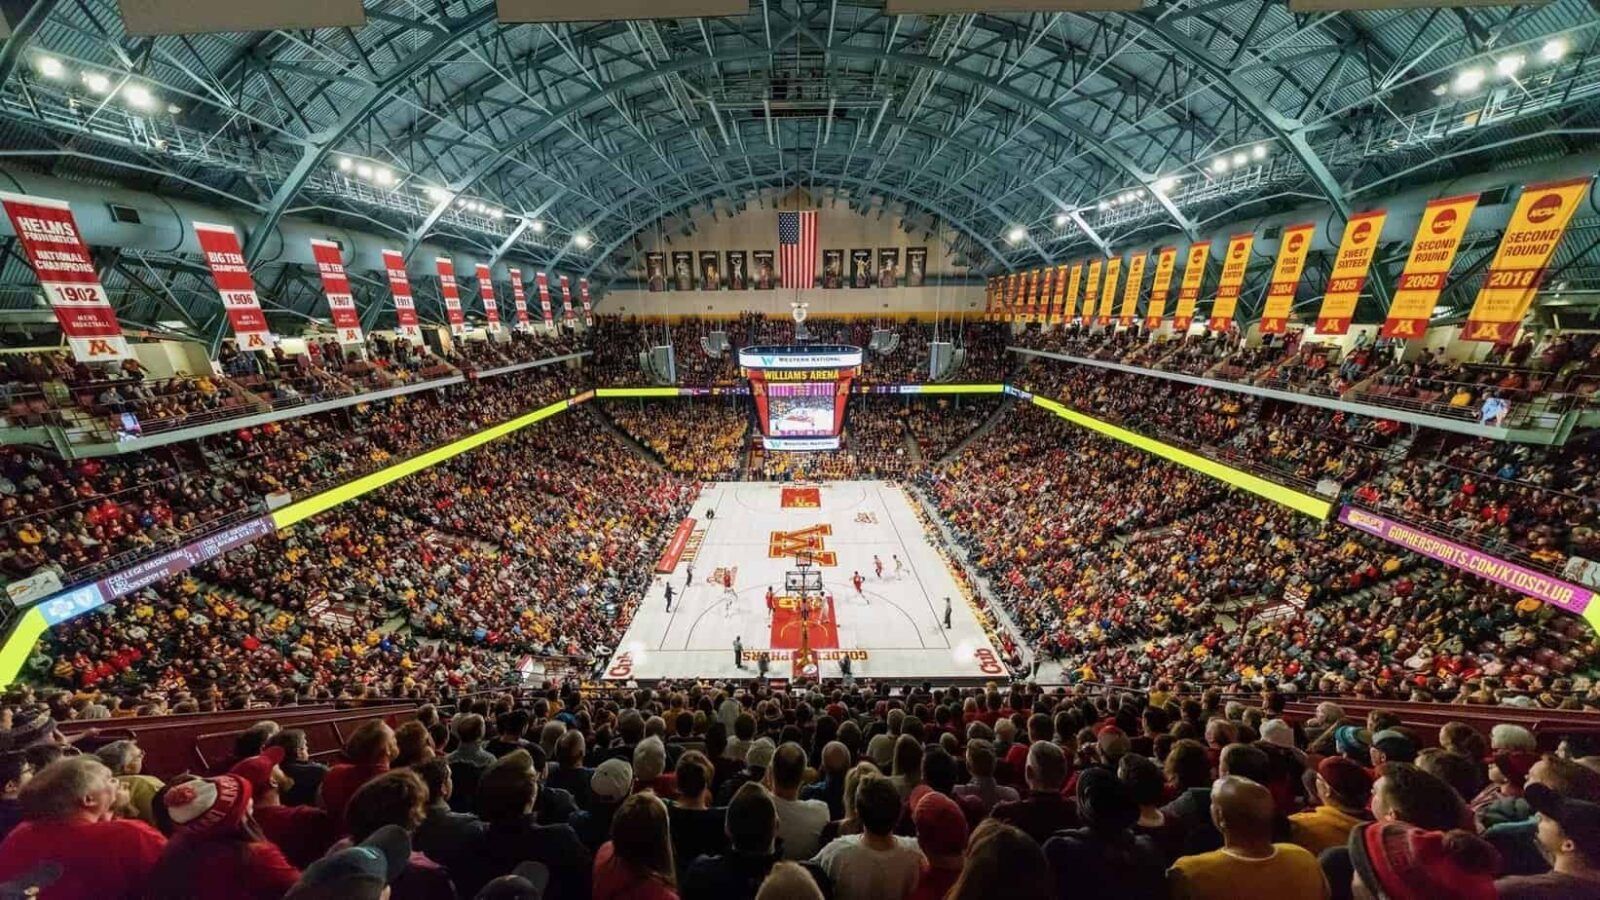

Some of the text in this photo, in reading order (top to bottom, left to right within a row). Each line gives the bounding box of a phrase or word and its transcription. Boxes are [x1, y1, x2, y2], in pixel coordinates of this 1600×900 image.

[16, 216, 74, 236] HELMS
[1508, 229, 1560, 243] SECOND
[1417, 238, 1456, 250] SECOND
[1504, 244, 1550, 257] ROUND
[36, 250, 86, 262] NATIONAL
[207, 251, 244, 264] BIG TEN
[1414, 250, 1449, 263] ROUND
[34, 260, 94, 273] CHAMPIONS
[1404, 274, 1440, 288] 2009
[1490, 272, 1534, 286] 2018
[56, 287, 100, 301] 1902
[227, 294, 254, 304] 1906
[1322, 319, 1340, 331] M
[1392, 320, 1415, 334] M
[1472, 322, 1501, 340] M
[249, 334, 265, 346] M
[88, 339, 118, 355] M
[764, 370, 839, 380] WILLIAMS ARENA
[108, 565, 144, 584] COLLEGE
[974, 648, 1002, 674] Cub
